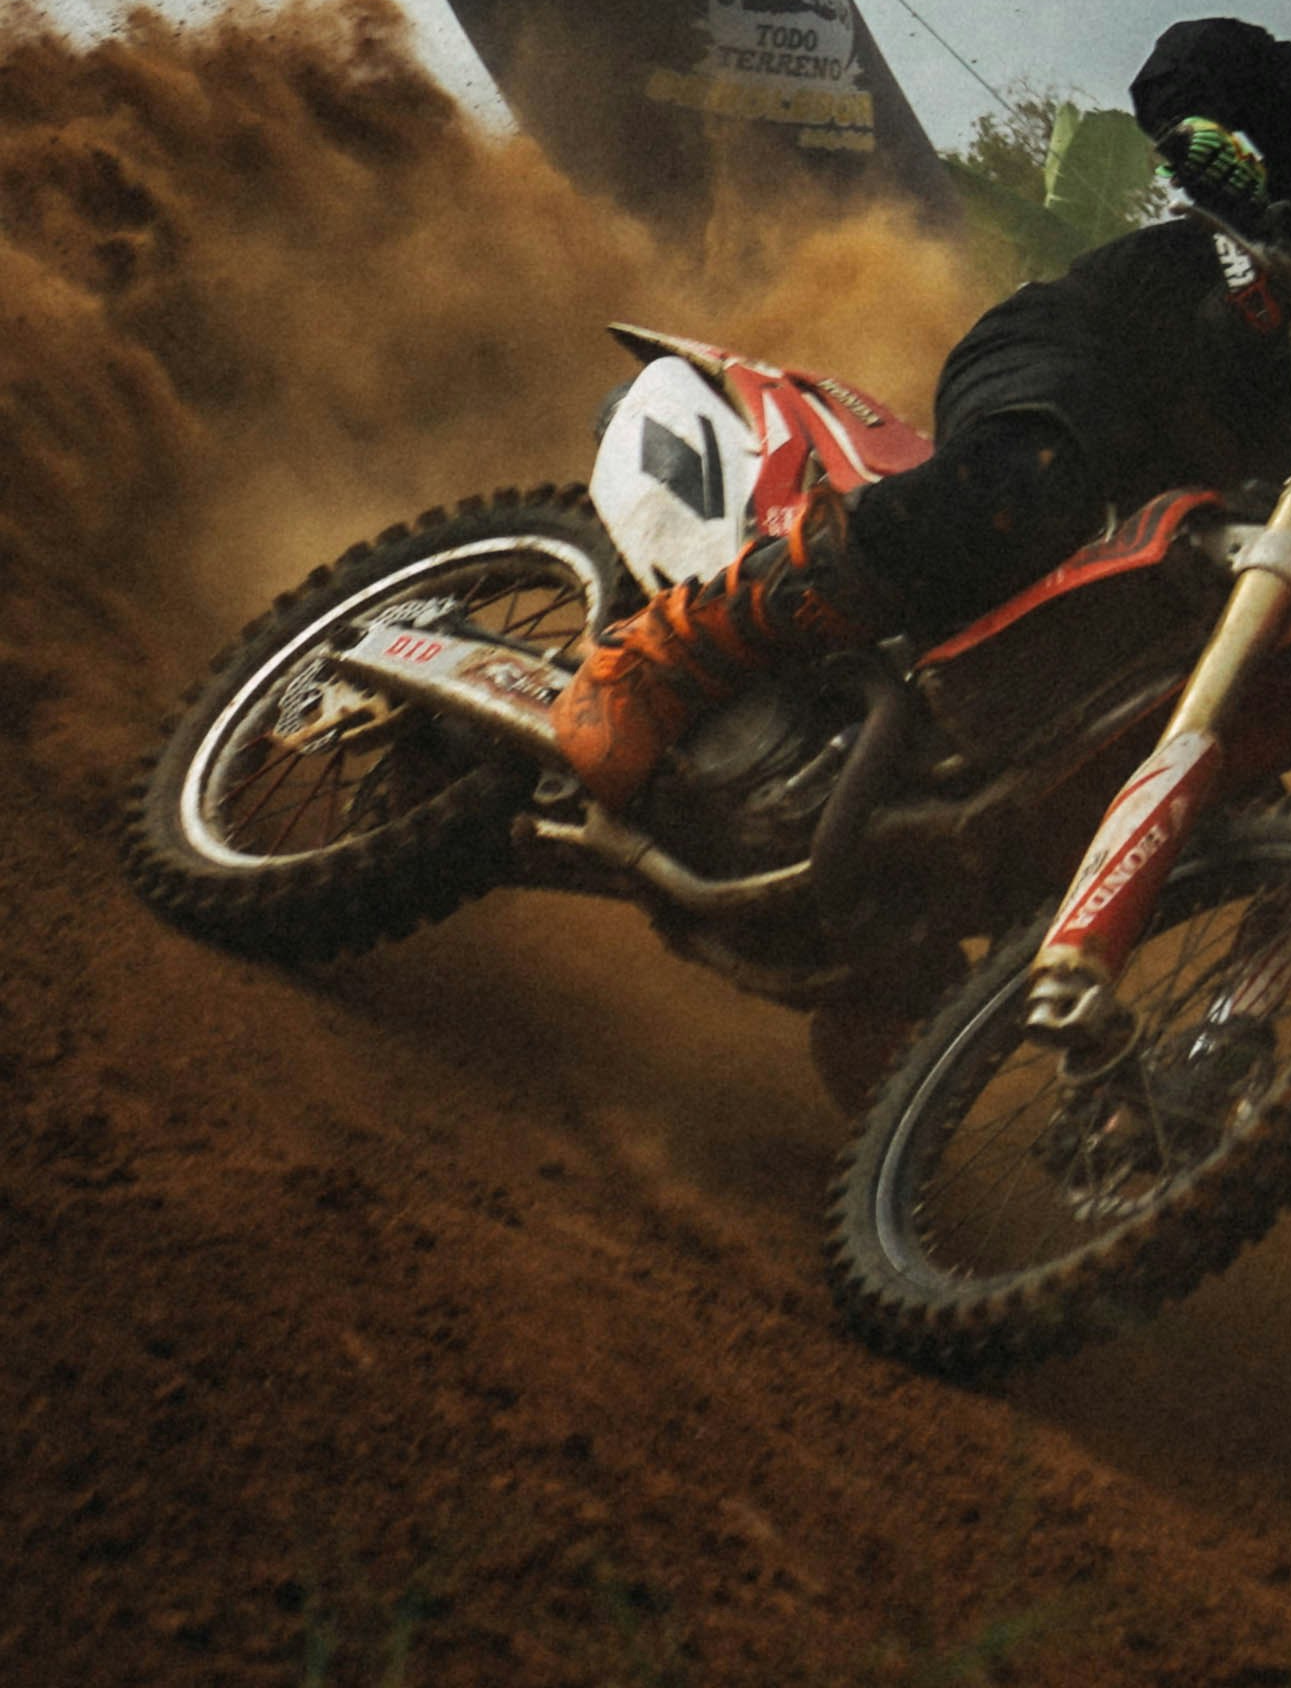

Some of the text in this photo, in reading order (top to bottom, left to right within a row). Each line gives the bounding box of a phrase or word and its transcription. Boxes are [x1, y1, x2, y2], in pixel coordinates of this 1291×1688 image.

[755, 23, 819, 52] TODO
[719, 47, 842, 81] TERRENO
[384, 635, 442, 664] DID
[1063, 825, 1168, 933] HONDA
